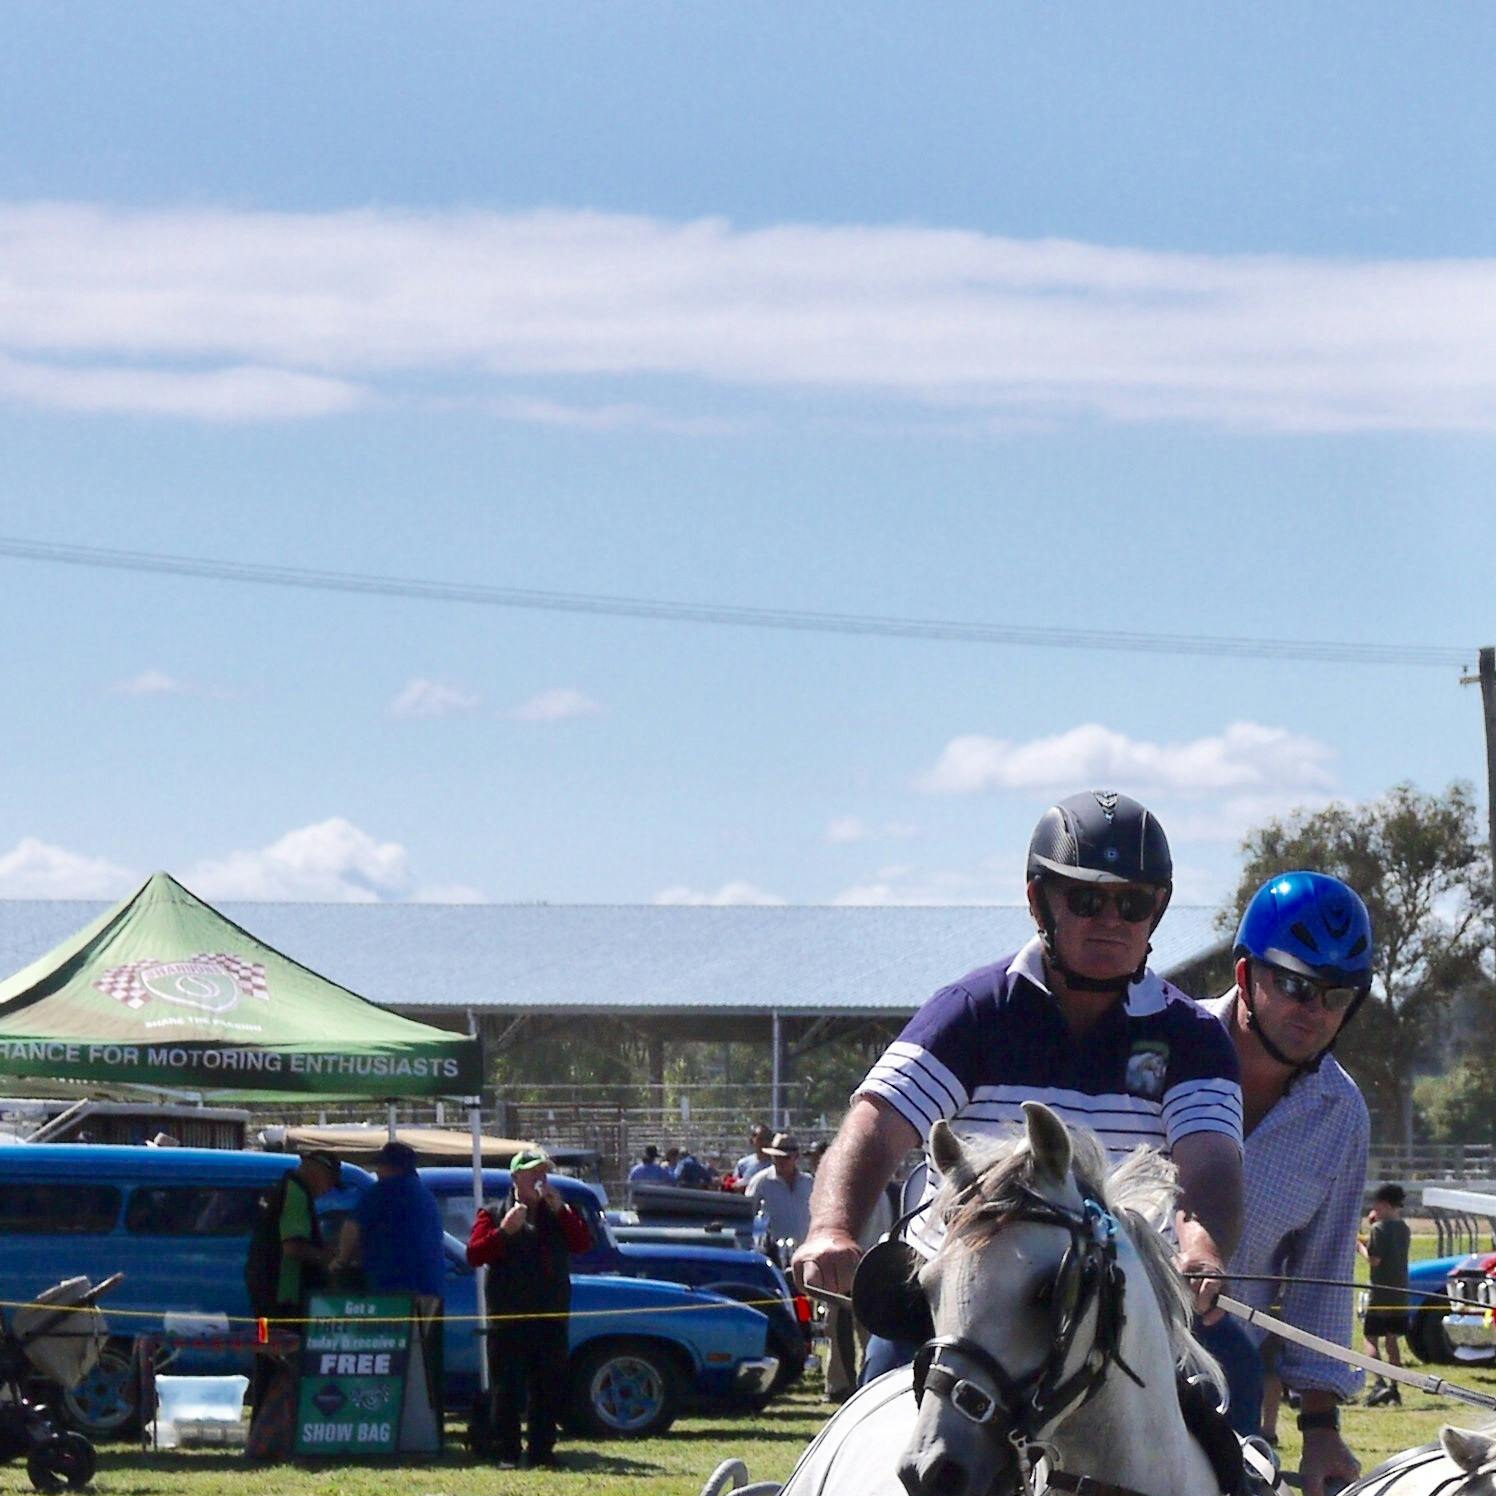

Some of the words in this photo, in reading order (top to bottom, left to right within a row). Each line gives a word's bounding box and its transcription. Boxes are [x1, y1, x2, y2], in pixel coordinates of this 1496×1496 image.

[89, 1045, 139, 1066] FOR
[147, 1049, 281, 1072] MOTORING
[290, 1053, 459, 1078] ENTHUSIASTS
[345, 1300, 365, 1315] Get
[320, 1353, 391, 1375] FREE
[303, 1423, 353, 1442] SHOW
[358, 1422, 390, 1442] BAG
